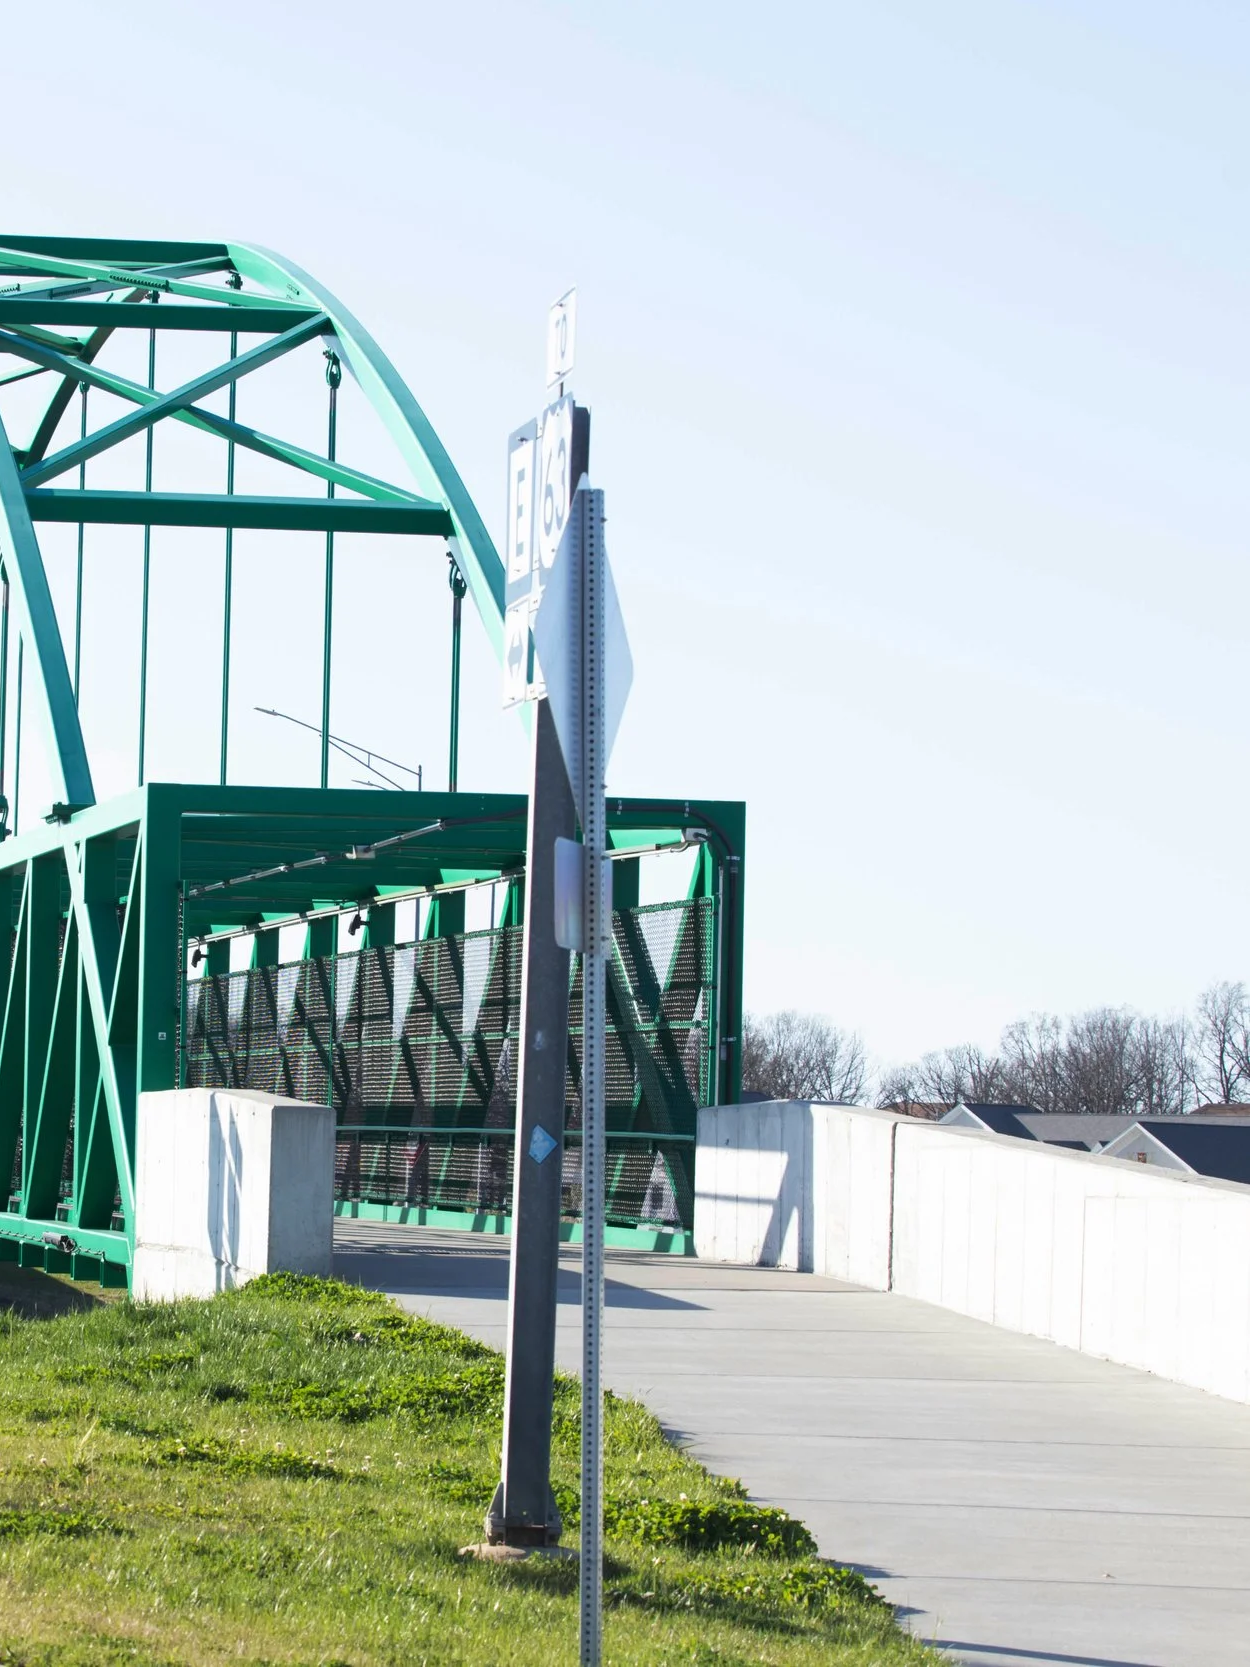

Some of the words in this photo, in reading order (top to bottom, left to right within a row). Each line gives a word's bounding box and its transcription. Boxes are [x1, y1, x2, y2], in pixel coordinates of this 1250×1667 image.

[555, 313, 568, 360] TO
[516, 467, 526, 557] E
[543, 437, 566, 537] 63
